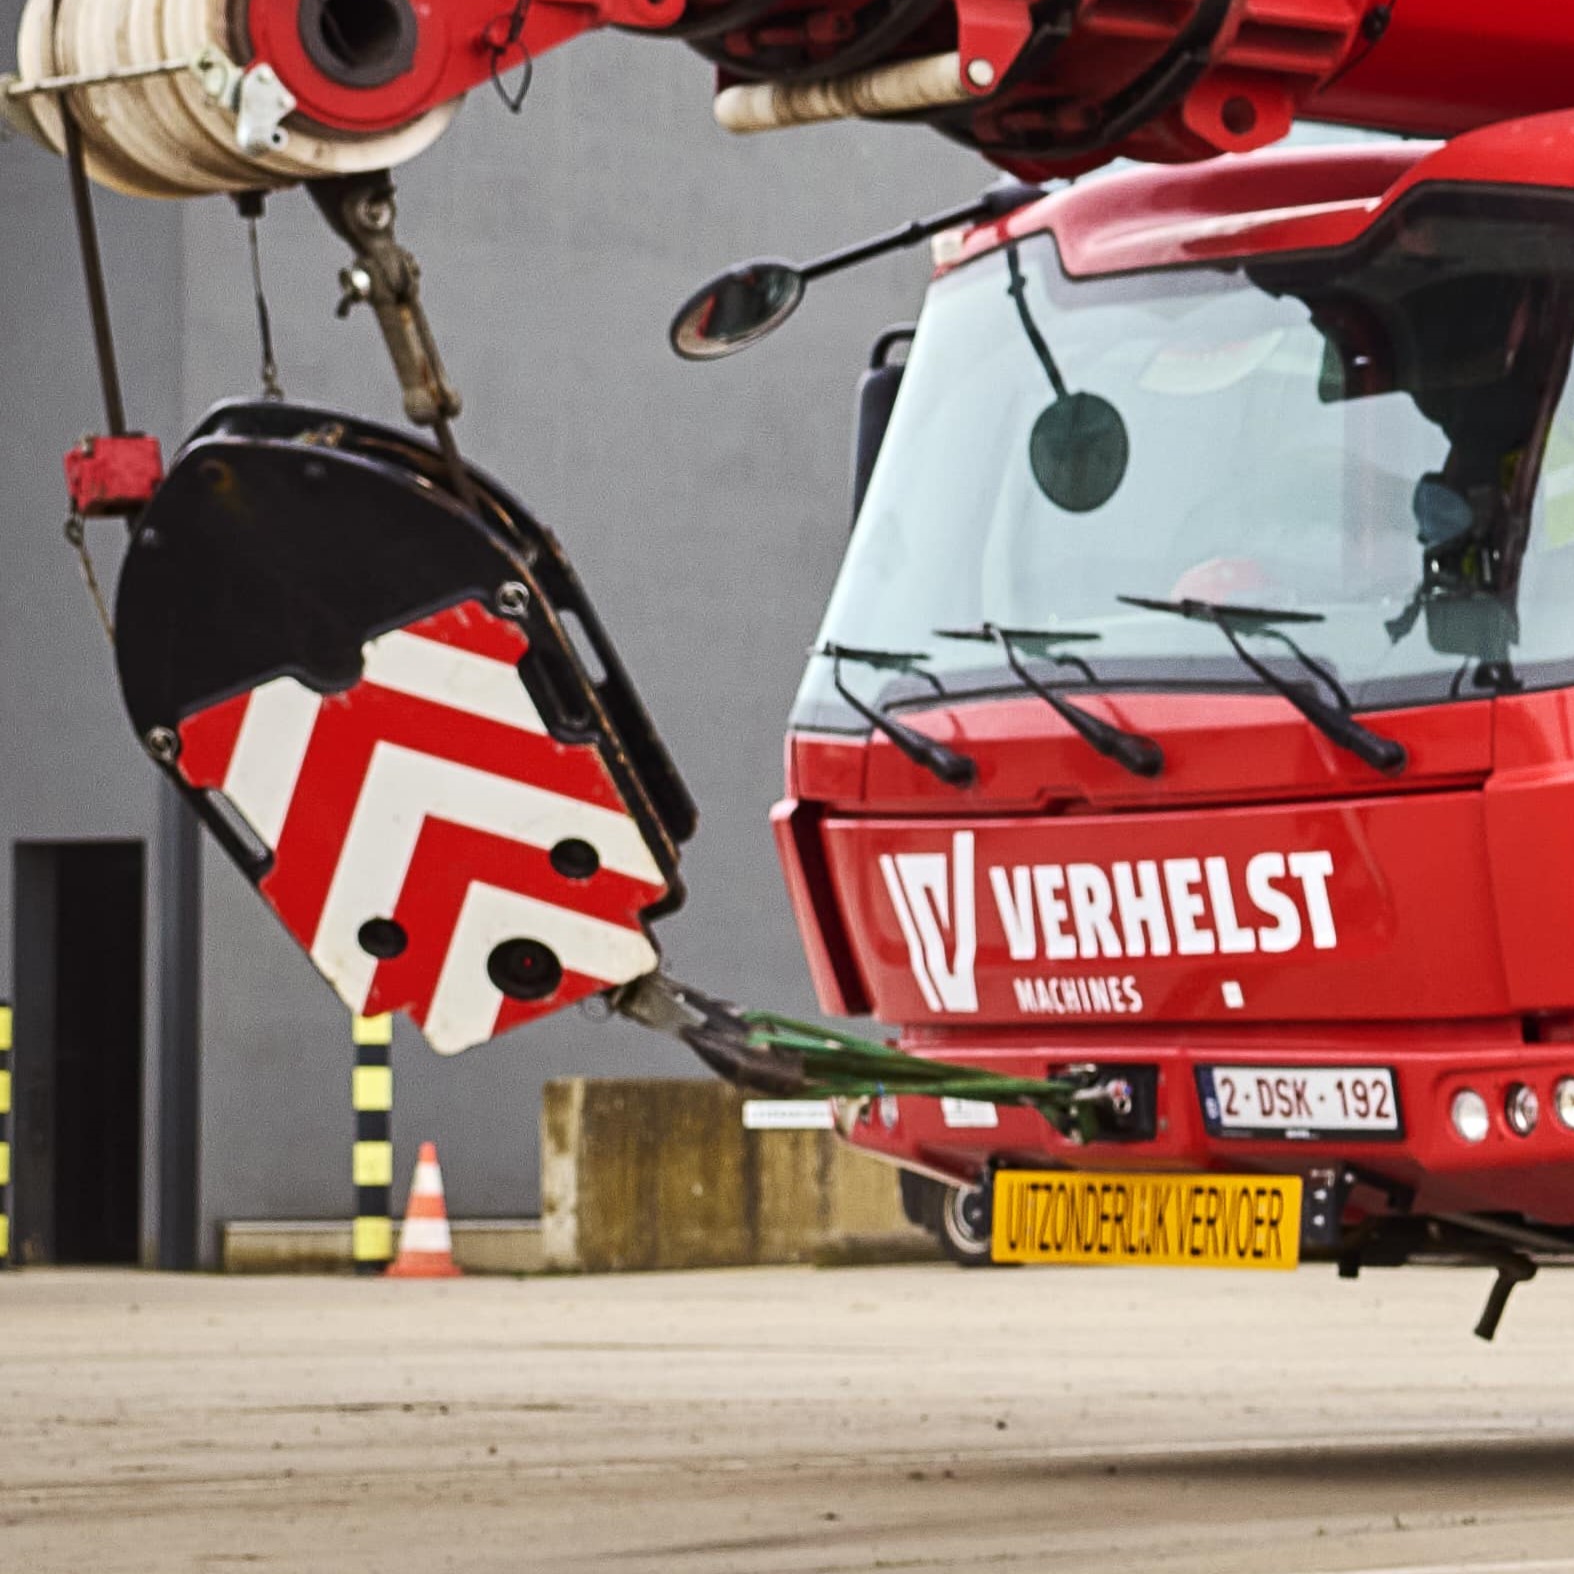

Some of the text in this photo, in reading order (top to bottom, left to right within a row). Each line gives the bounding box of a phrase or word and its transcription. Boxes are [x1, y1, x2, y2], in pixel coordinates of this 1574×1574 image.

[988, 850, 1338, 960] VERHELST
[1012, 974, 1143, 1014] MACHINES
[1176, 1186, 1285, 1259] VERVOER
